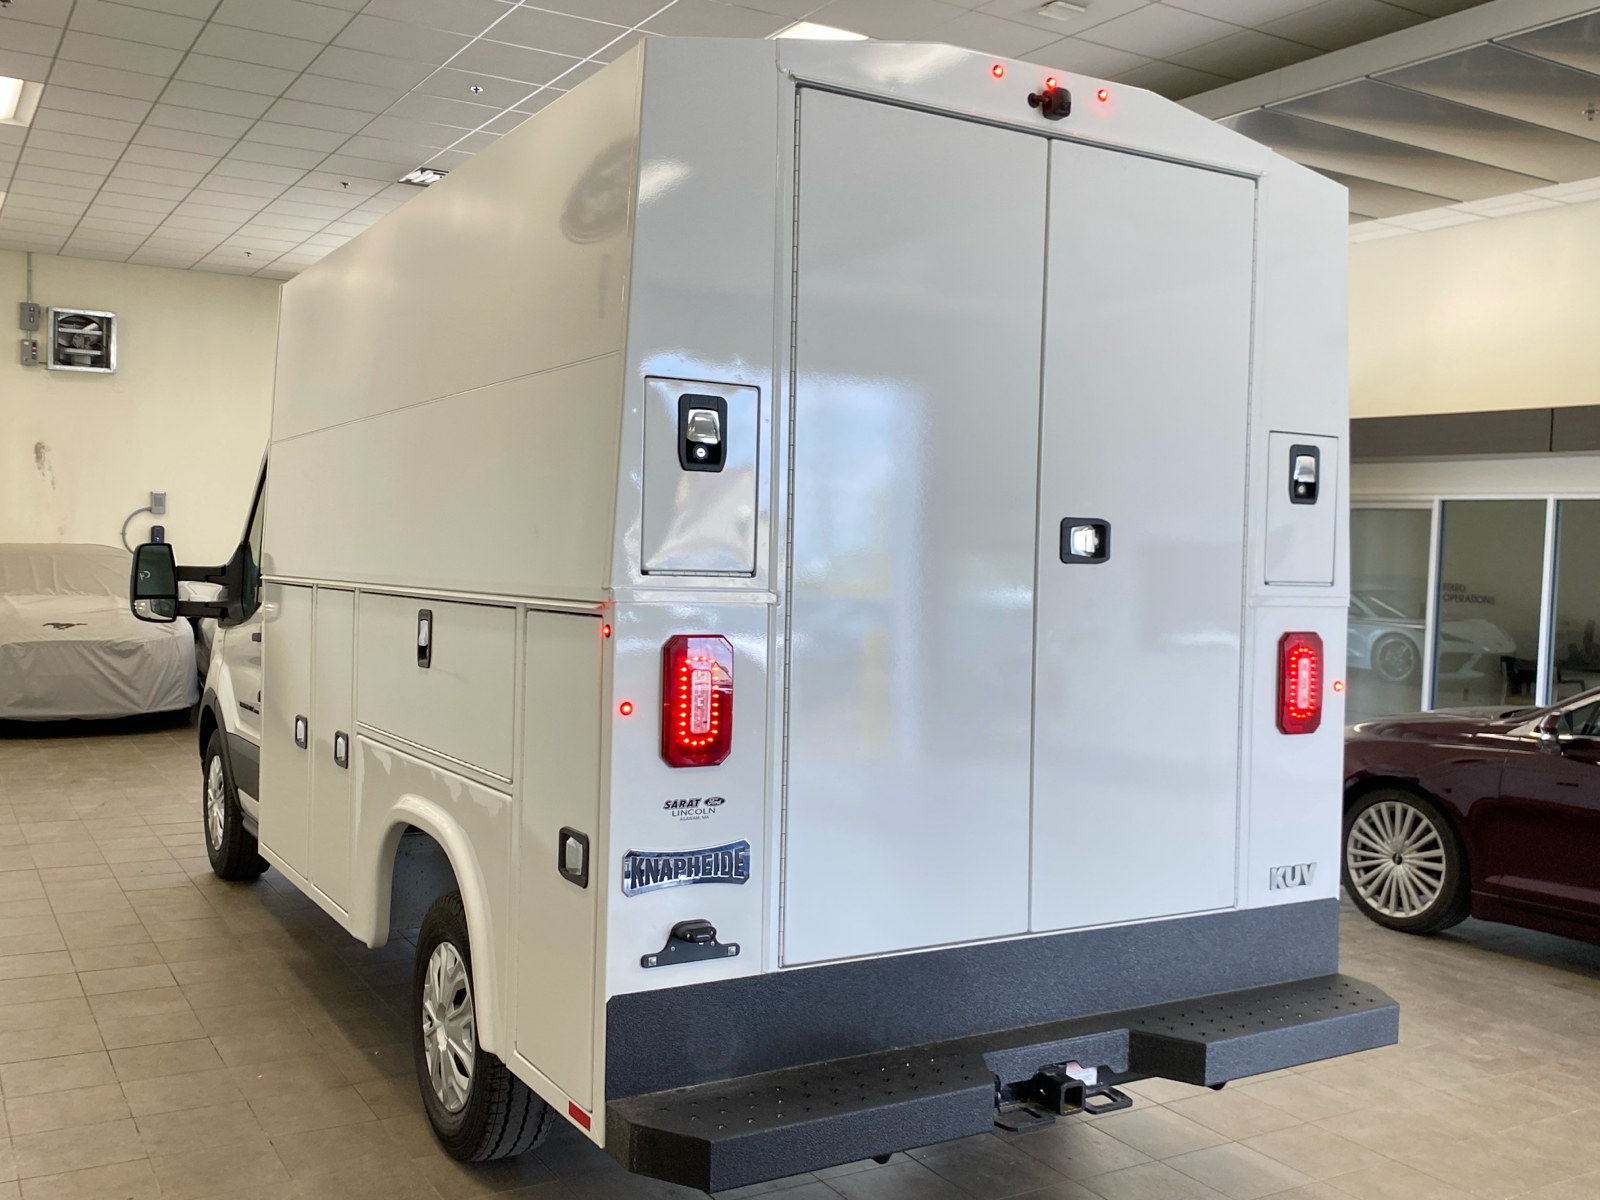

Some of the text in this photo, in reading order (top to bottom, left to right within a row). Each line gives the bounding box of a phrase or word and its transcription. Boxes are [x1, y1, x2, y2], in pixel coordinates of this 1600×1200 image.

[1442, 584, 1466, 592] FIXED
[1442, 594, 1496, 605] OPERATIONS
[663, 796, 726, 810] SARAT Ford
[672, 808, 716, 816] LINCOLN
[630, 847, 746, 889] KNAPHEIDE
[1269, 862, 1317, 890] KUV
